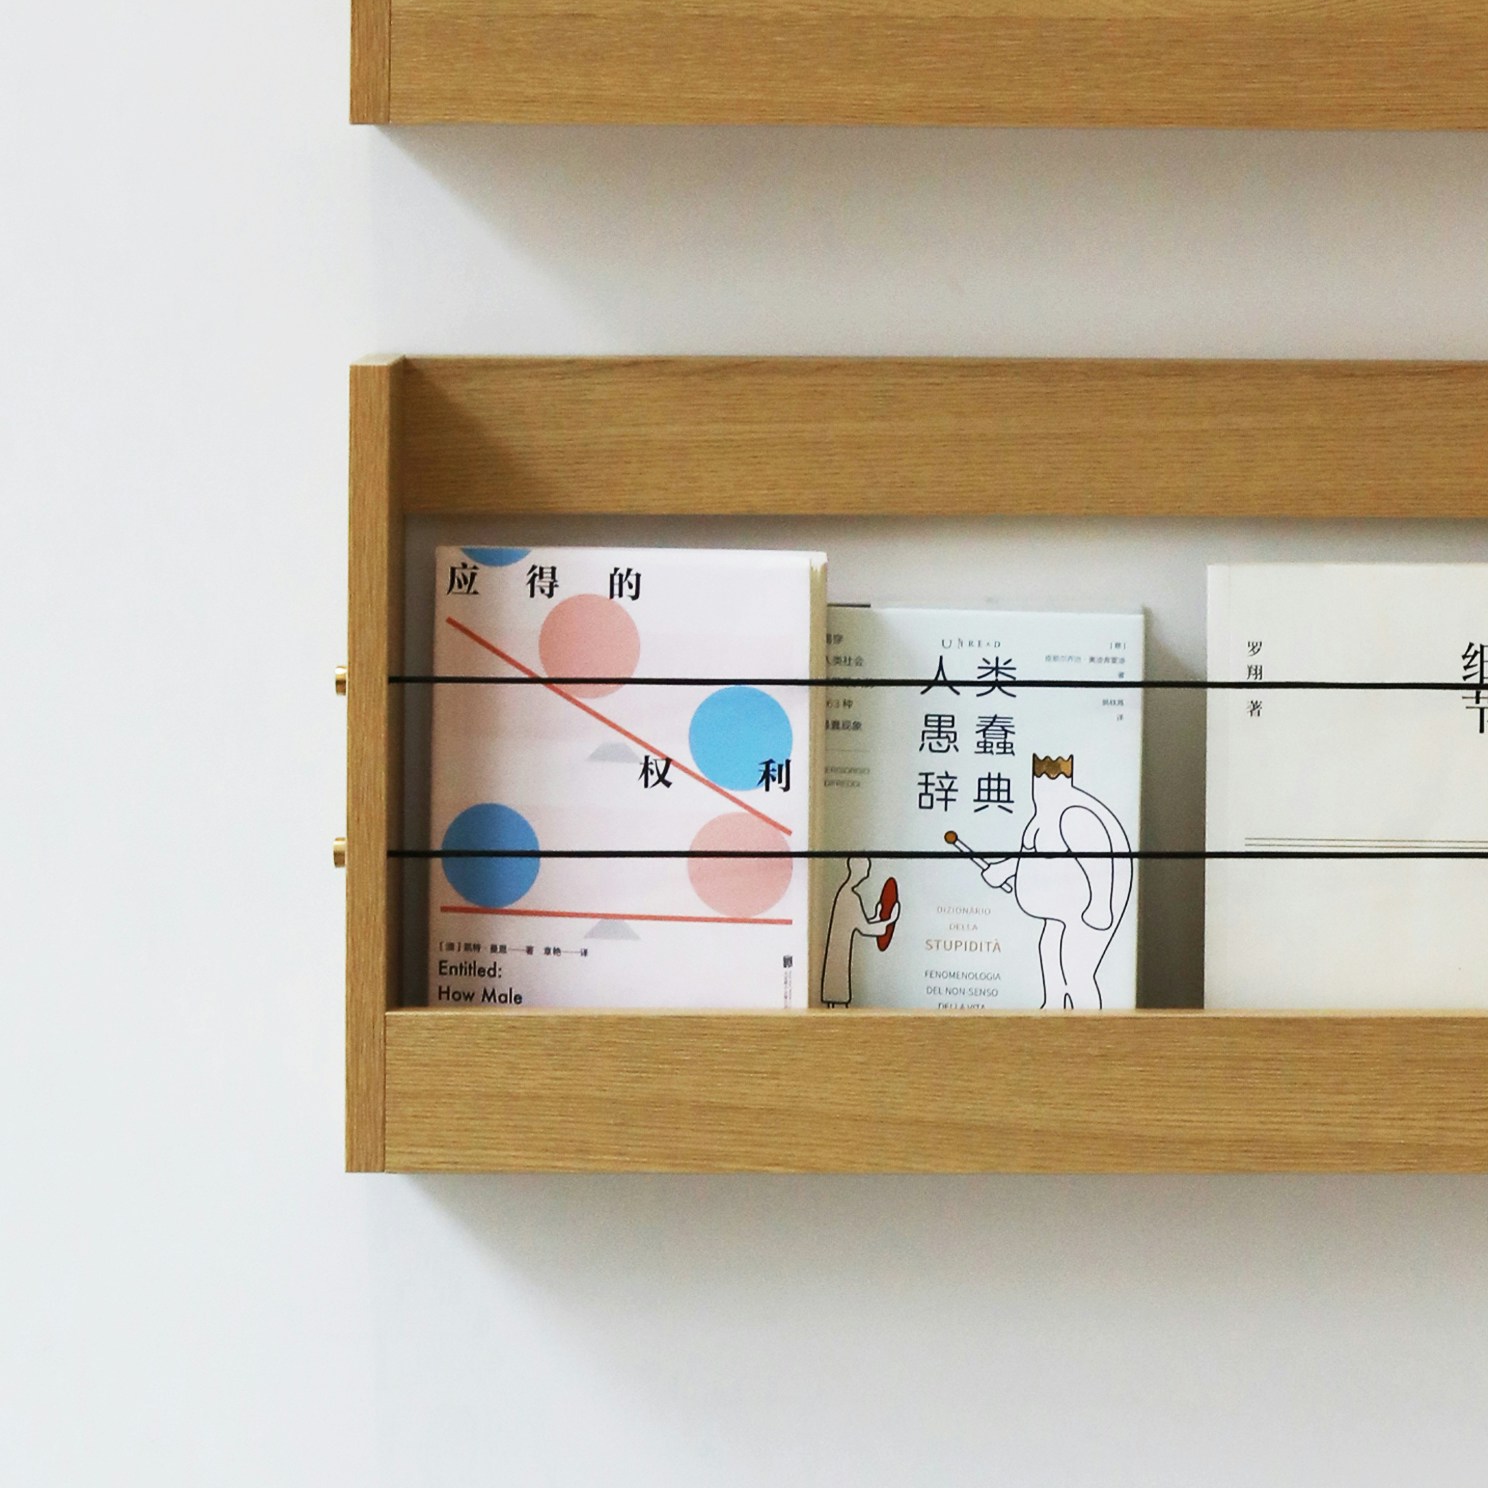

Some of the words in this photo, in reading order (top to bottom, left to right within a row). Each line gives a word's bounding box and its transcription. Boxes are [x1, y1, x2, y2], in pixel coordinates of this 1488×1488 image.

[919, 655, 1018, 699] 人类
[918, 713, 1016, 756] 愚蠢
[917, 770, 1015, 815] 辞典
[936, 905, 992, 916] DIZIONARIO
[924, 937, 1002, 953] STUPIDITÀ
[438, 959, 502, 978] Entitled:
[924, 969, 1002, 981] FENOMENOLOGIA
[438, 985, 476, 1002] How
[481, 987, 523, 1005] Male
[926, 985, 944, 996] DEL
[968, 987, 999, 998] SENSO
